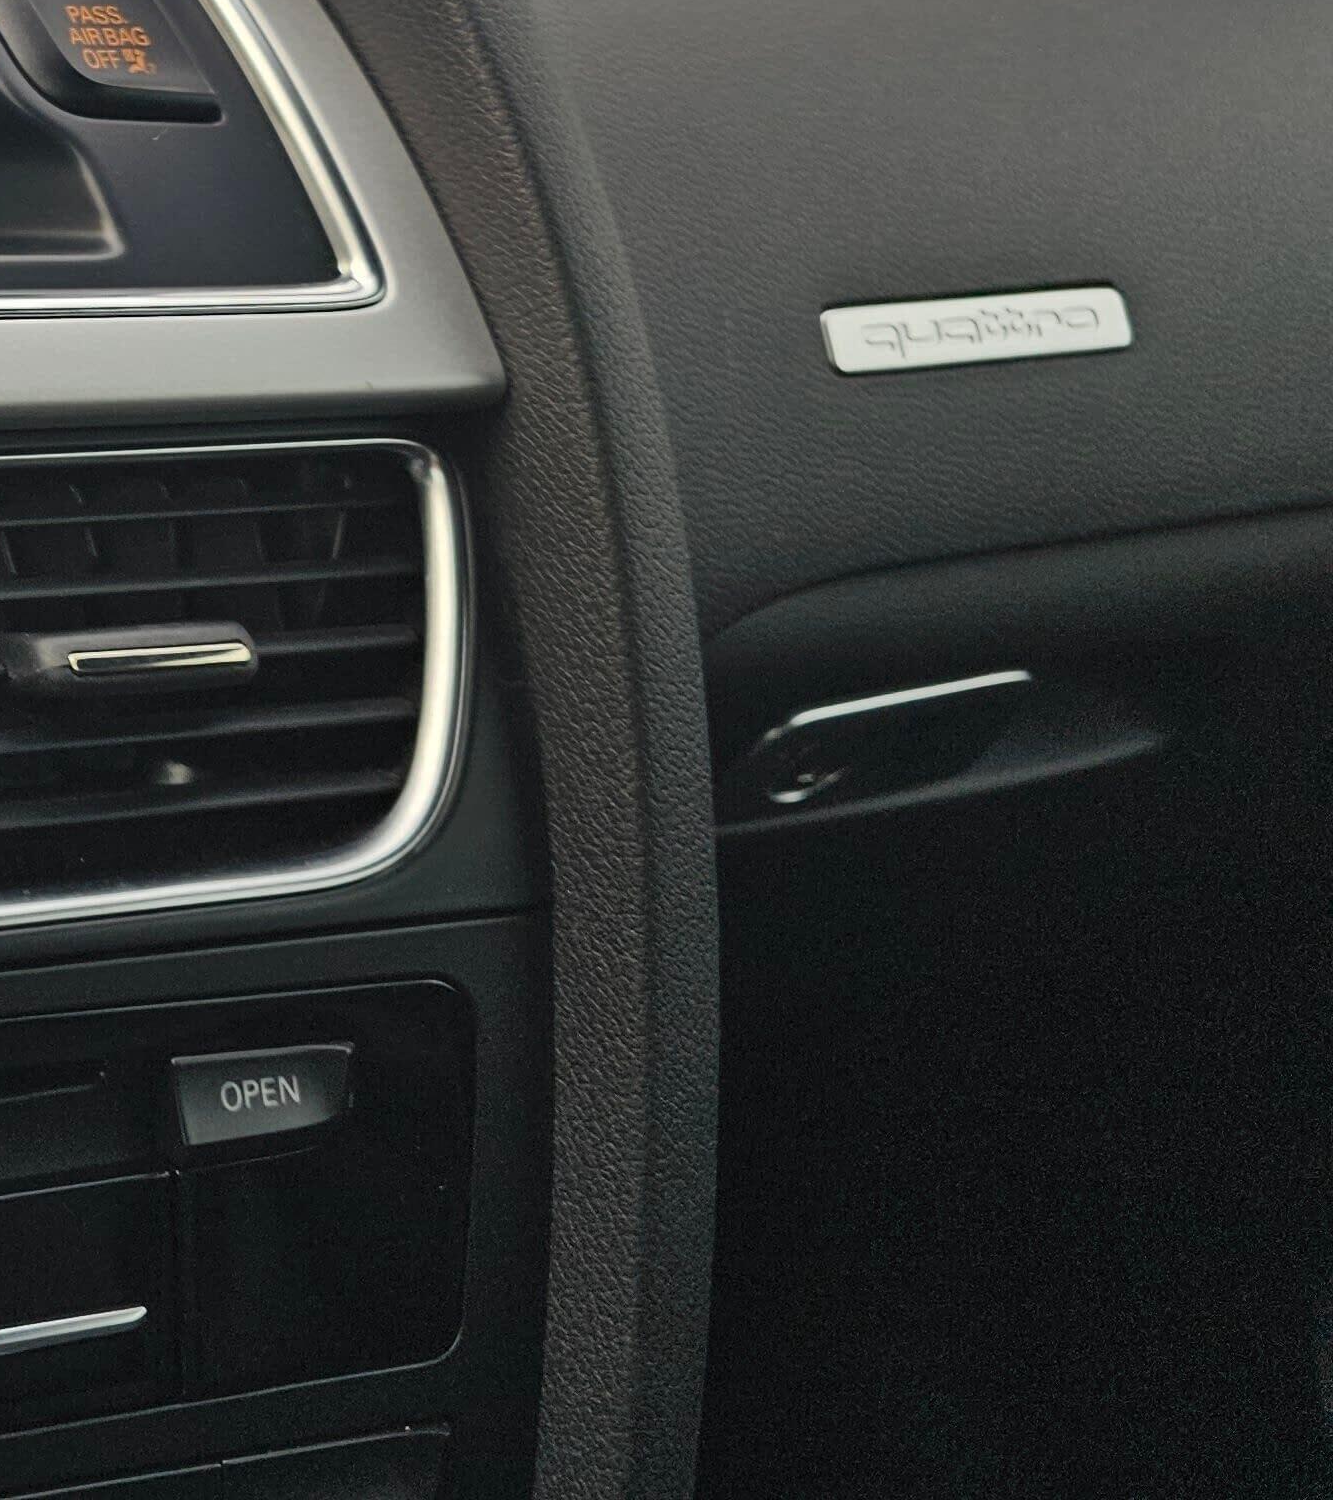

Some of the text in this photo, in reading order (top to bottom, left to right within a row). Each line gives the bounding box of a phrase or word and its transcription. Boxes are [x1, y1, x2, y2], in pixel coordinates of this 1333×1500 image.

[64, 5, 128, 25] PASS.
[69, 26, 151, 47] AIRBAG
[83, 50, 120, 69] OFF
[861, 306, 1099, 358] quattro
[220, 1075, 301, 1112] OPEN
